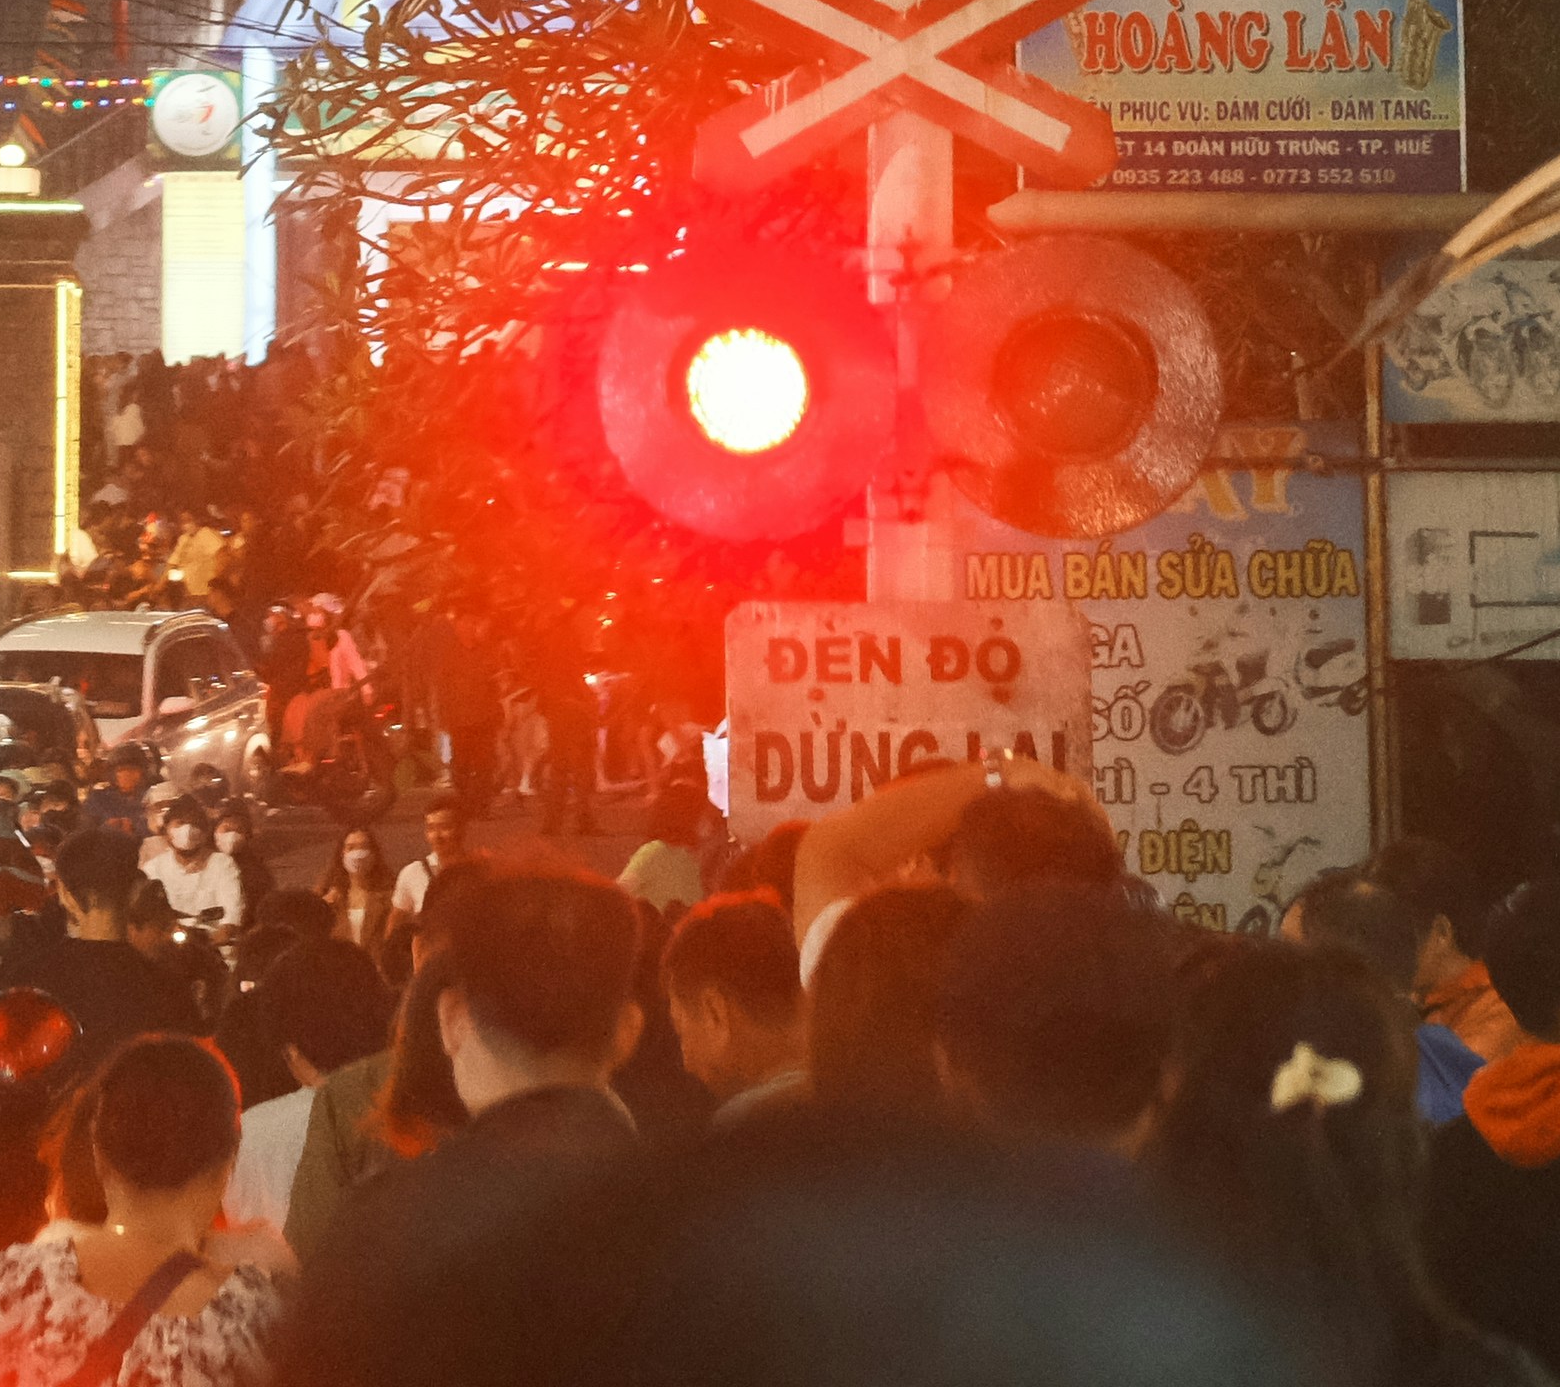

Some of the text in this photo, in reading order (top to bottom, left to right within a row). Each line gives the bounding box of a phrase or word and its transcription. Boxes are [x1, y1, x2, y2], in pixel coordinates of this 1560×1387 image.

[1119, 100, 1170, 128] PHỤC
[1179, 100, 1210, 128] VỤ:
[1217, 95, 1260, 123] ĐÁM
[1266, 95, 1311, 122] CƯỚI
[1330, 94, 1375, 123] ĐÁM
[1143, 140, 1167, 157] 14
[1172, 136, 1225, 157] ĐOÀN
[1230, 135, 1271, 157] HỮU
[1278, 138, 1340, 157] TRƯNG
[1359, 139, 1390, 157] TP.
[1393, 133, 1433, 156] HUẾ
[1111, 168, 1162, 186] 0935
[1166, 168, 1203, 186] 223
[1262, 167, 1312, 185] 0773
[1317, 167, 1353, 185] 552
[966, 532, 1359, 601] MUA BÁN SỬA CHỮA
[763, 616, 903, 686] ĐÈN
[1182, 765, 1220, 804] 4
[1229, 756, 1317, 804] THÌ
